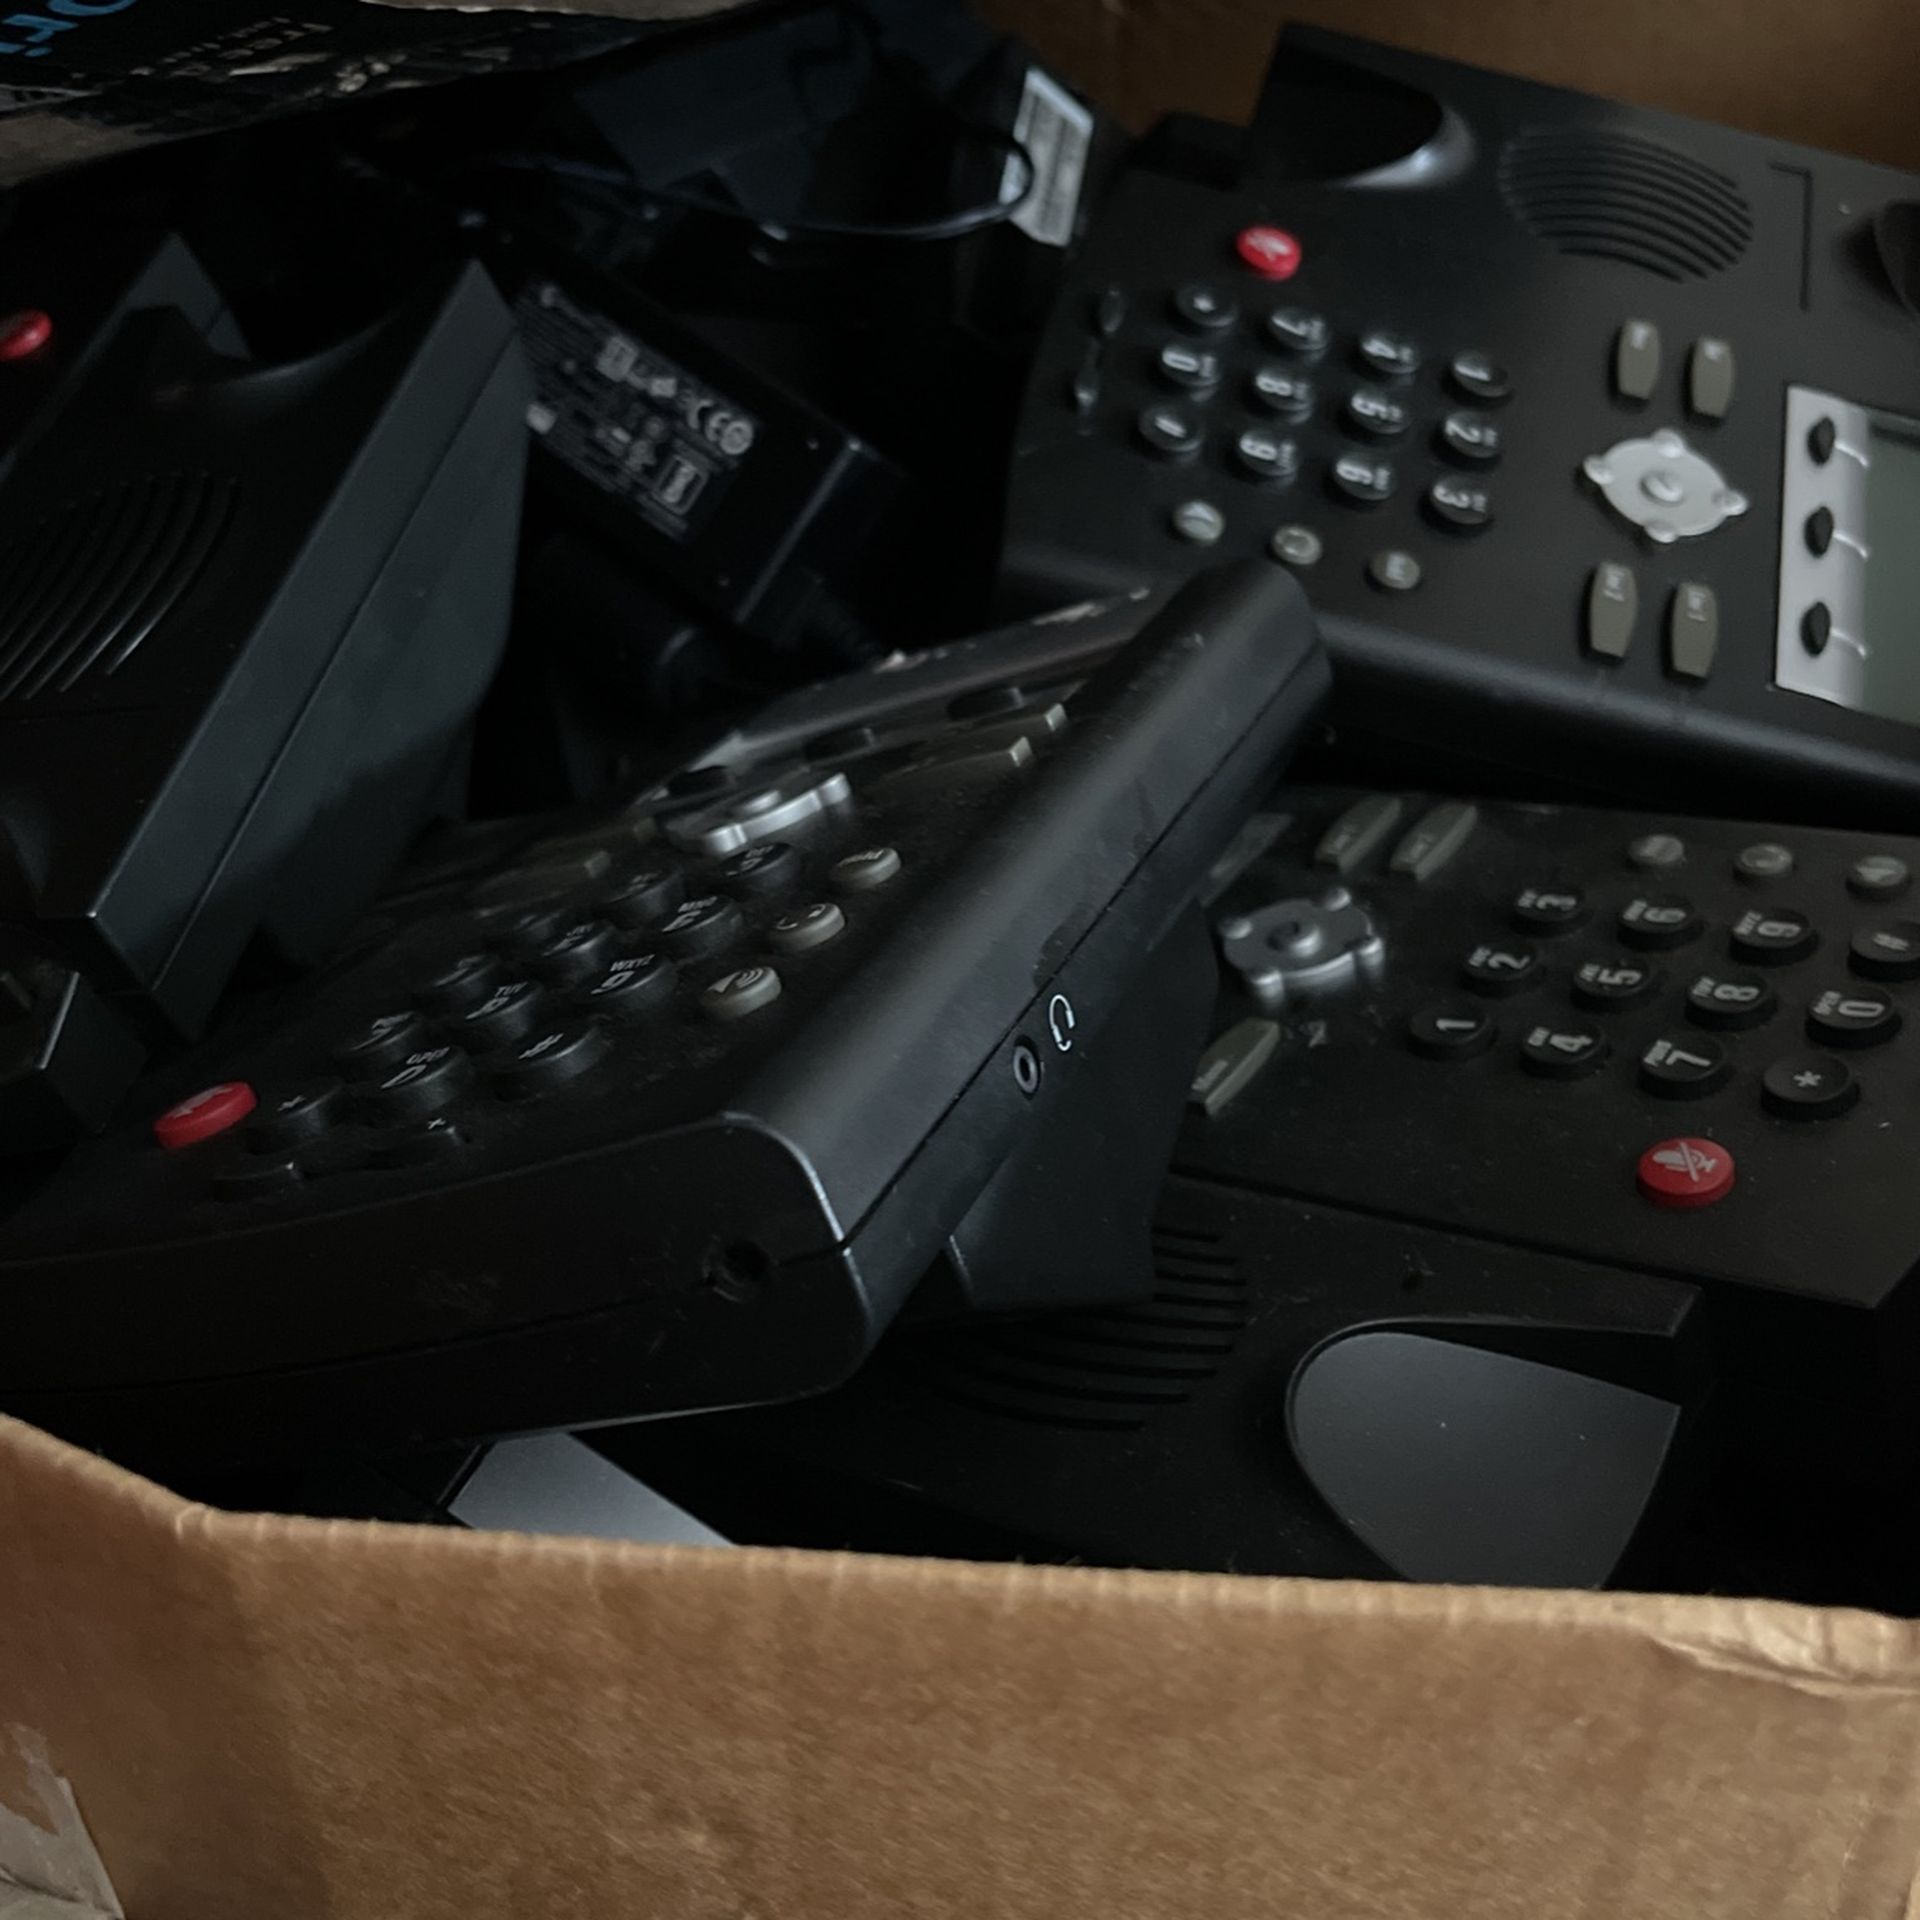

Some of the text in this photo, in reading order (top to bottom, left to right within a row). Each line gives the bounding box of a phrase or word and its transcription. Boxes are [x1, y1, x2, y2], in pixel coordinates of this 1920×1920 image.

[1161, 349, 1200, 373] 0
[1255, 373, 1294, 397] 8
[1444, 419, 1482, 444] 2
[1431, 483, 1471, 509] 3
[1535, 893, 1578, 912] 3
[1642, 906, 1687, 924] 6
[1756, 920, 1801, 938] 9
[1487, 952, 1531, 970] 2
[591, 970, 635, 994] 9
[1597, 968, 1643, 985] 5
[1713, 983, 1761, 1002] 8
[1837, 1000, 1886, 1018] 0
[1435, 1017, 1477, 1031] 1
[1549, 1033, 1594, 1052] 4
[1664, 1049, 1713, 1068] 7
